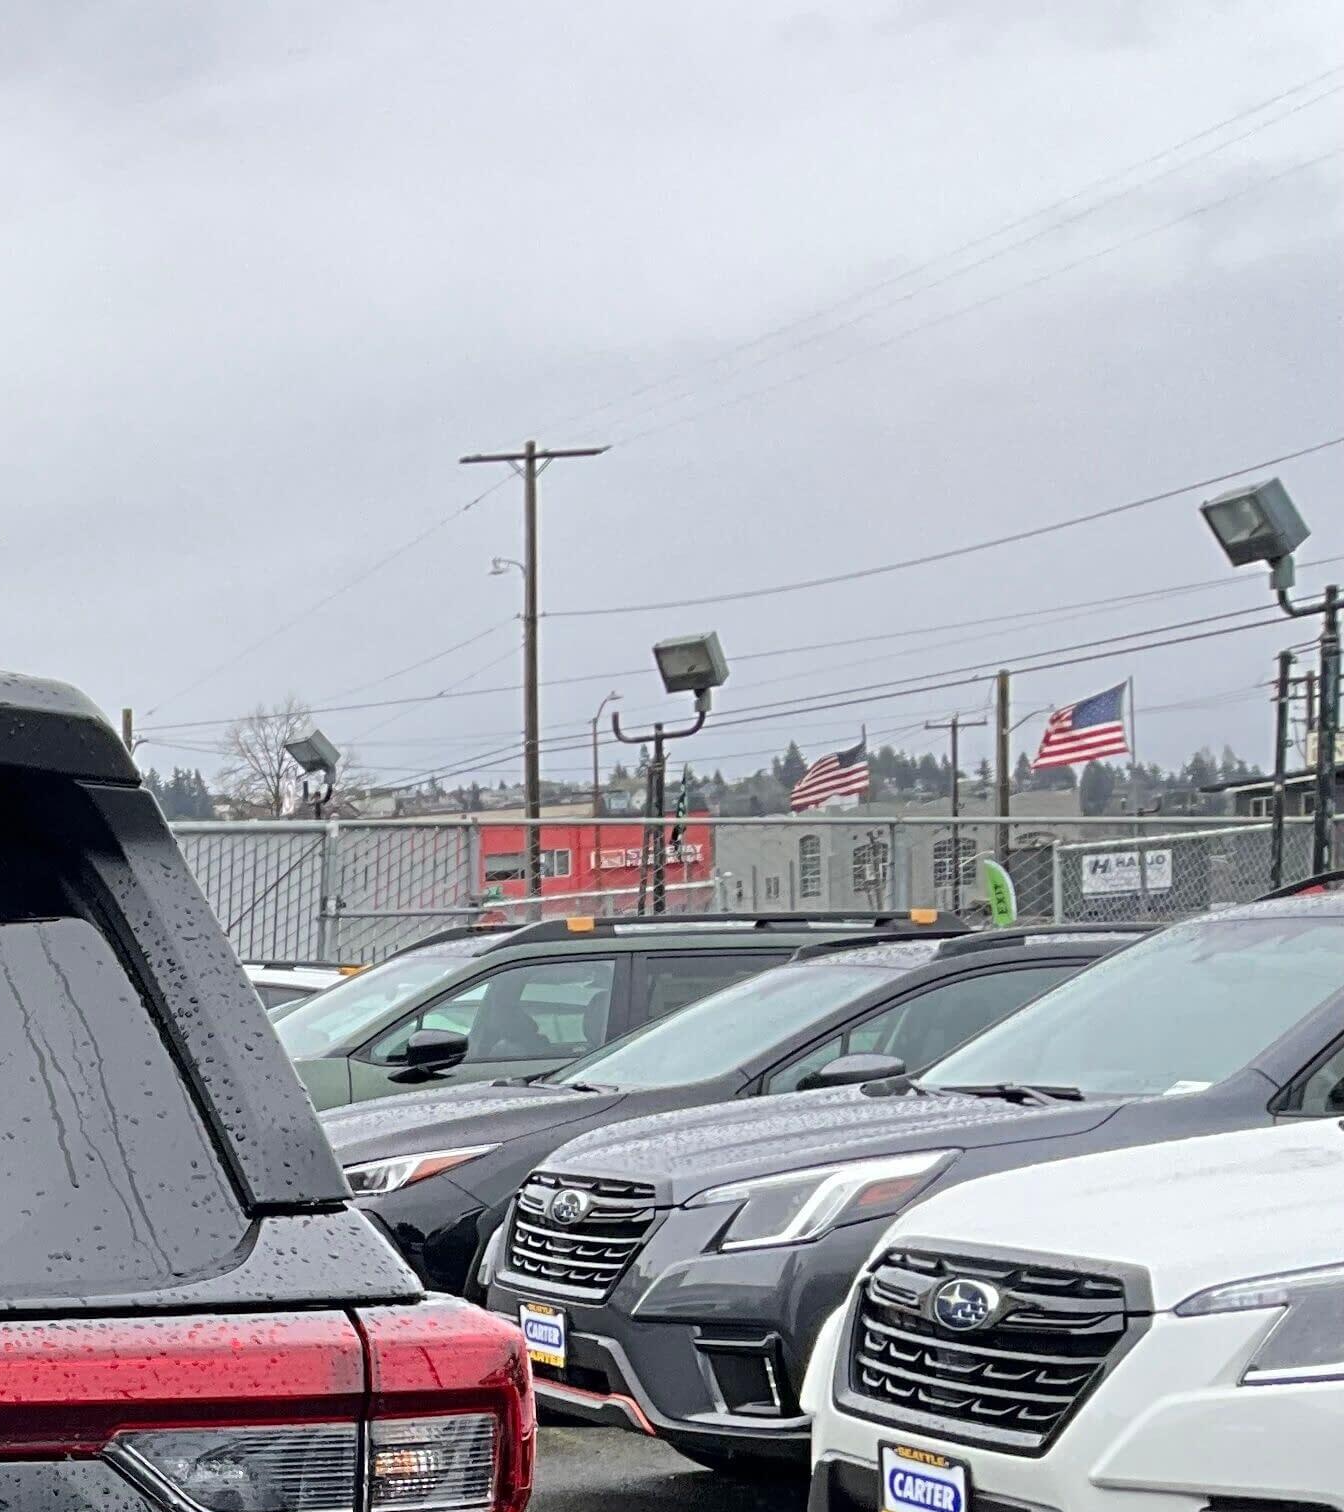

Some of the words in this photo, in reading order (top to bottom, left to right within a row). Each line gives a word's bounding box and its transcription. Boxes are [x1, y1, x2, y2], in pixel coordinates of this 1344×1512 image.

[1115, 854, 1166, 867] HAJO
[526, 1321, 561, 1346] CARTER
[896, 1446, 946, 1467] SEATTLE
[893, 1472, 955, 1512] CARTER
